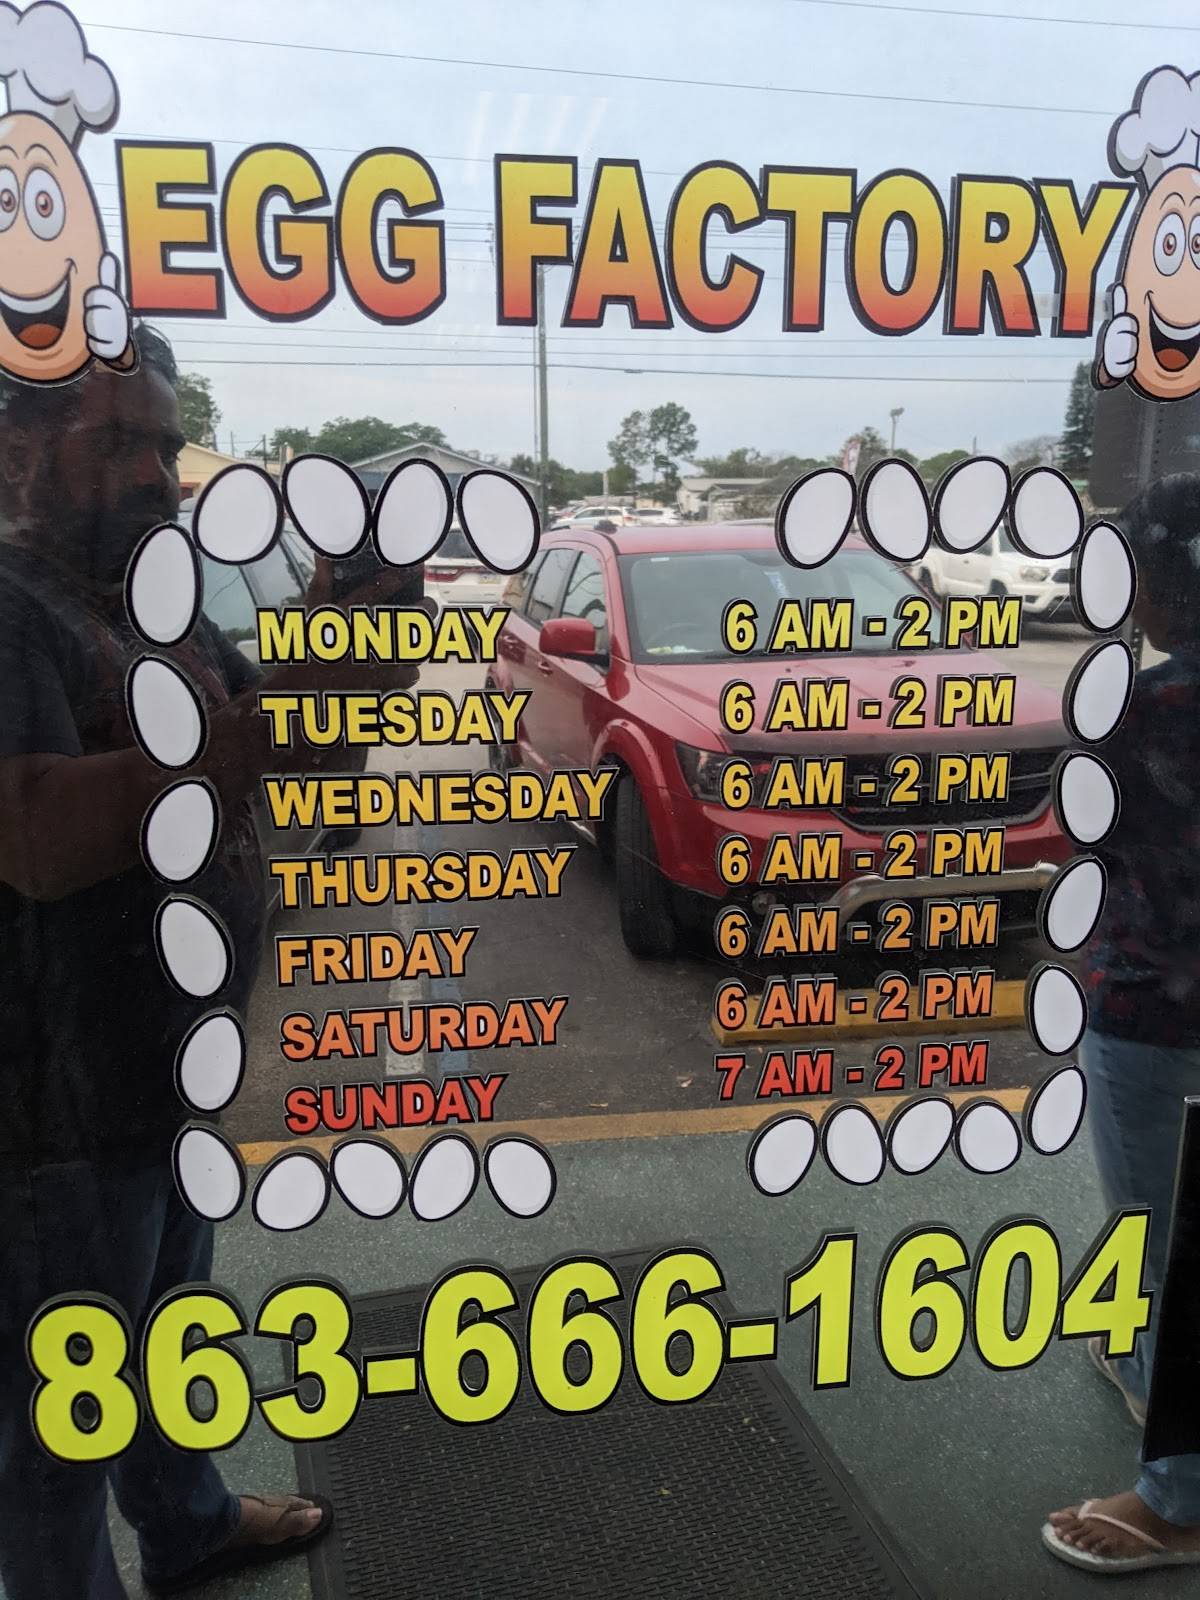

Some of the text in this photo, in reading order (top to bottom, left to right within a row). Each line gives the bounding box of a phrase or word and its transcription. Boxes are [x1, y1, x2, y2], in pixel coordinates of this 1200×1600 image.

[115, 139, 1137, 338] EGG FACTORY
[257, 607, 511, 664] MONDAY
[724, 596, 1022, 654] 6 AM - 2 PM
[259, 690, 533, 749] TUESDAY
[722, 675, 1016, 734] 6 AM - 2 PM
[262, 767, 620, 830] WEDNESDAY
[720, 752, 1011, 811] 6 AM - 2 PM
[269, 844, 578, 910] THURSDAY
[719, 827, 1005, 885] 6 AM - 2 PM
[275, 926, 480, 987] FRIDAY
[717, 900, 1000, 959] 6 AM - 2 PM
[280, 996, 569, 1062] SATURDAY
[715, 970, 995, 1030] 6 AM - 2 PM
[716, 1040, 990, 1100] 7 AM - 2 PM
[285, 1073, 509, 1135] SUNDAY
[28, 1206, 1153, 1463] 863-666-1604
